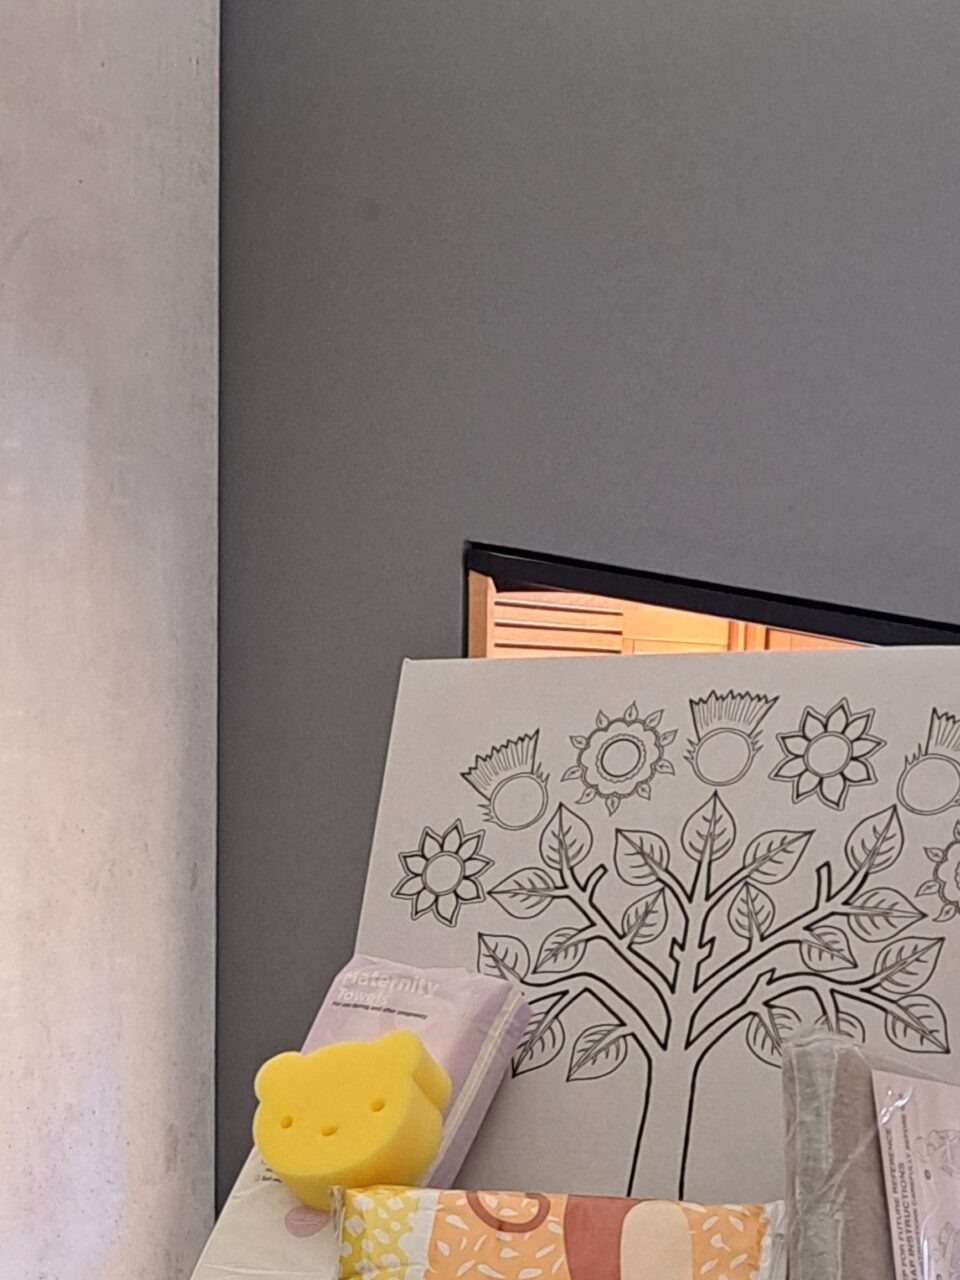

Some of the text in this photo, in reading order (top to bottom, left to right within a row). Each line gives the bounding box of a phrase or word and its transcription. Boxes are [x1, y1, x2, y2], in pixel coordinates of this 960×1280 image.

[338, 987, 388, 1006] Towels
[885, 1127, 898, 1194] REFERENCE
[898, 1161, 916, 1257] INSTRUCTIONS
